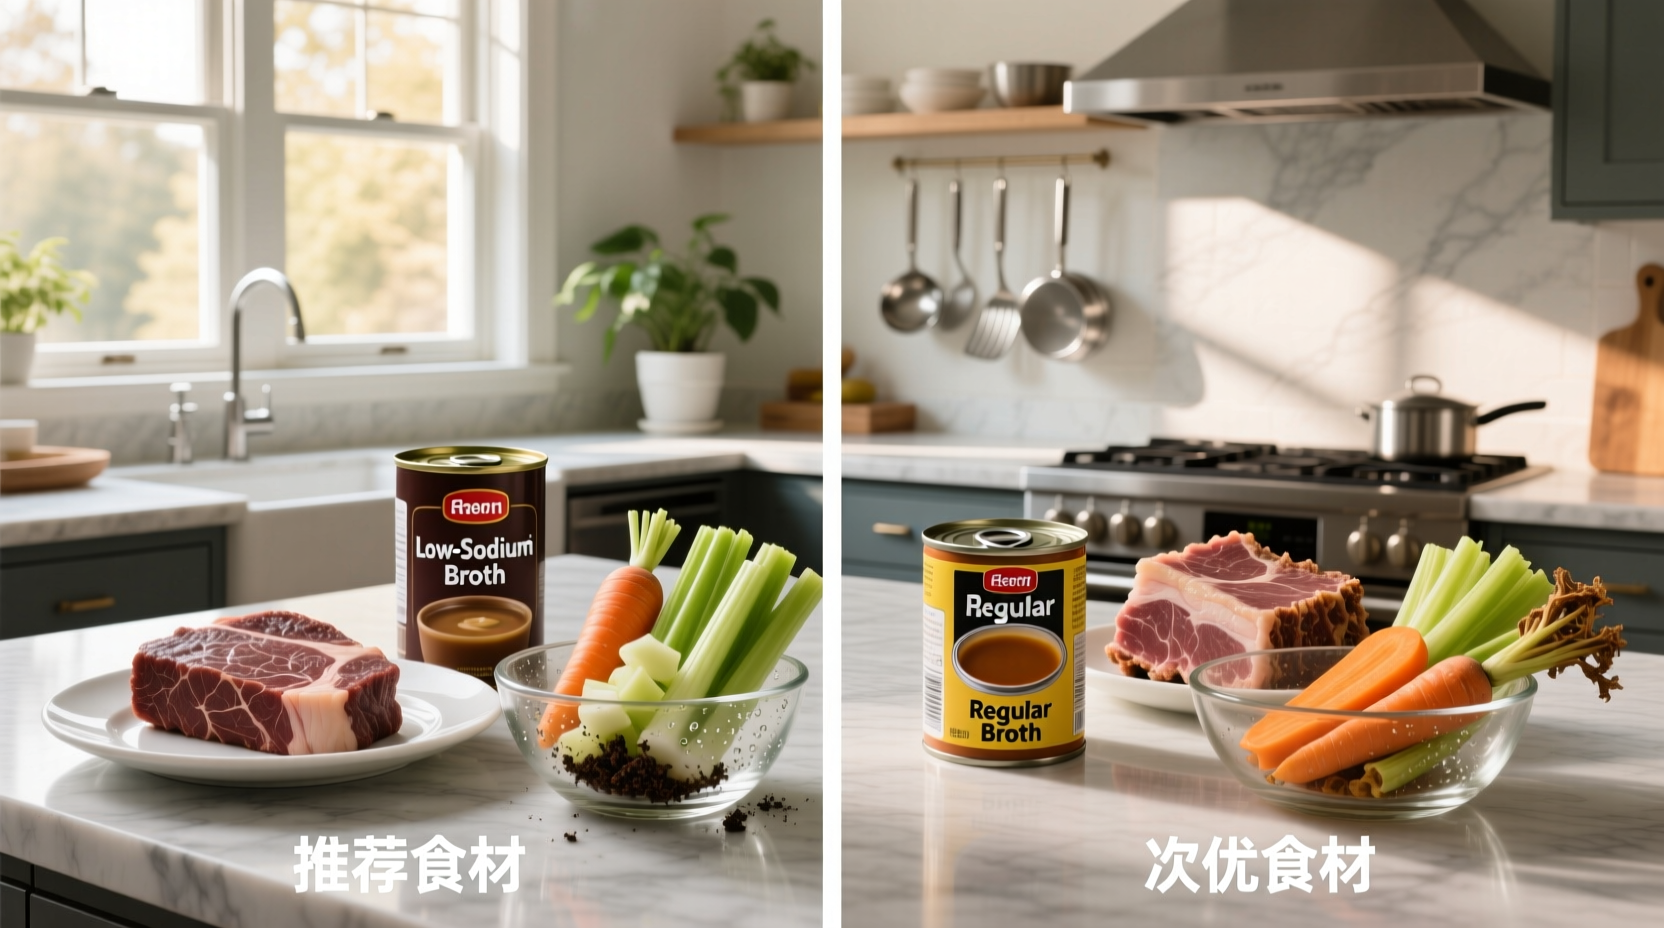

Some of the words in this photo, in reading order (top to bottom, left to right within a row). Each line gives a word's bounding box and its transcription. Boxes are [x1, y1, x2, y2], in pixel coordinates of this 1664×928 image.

[415, 534, 533, 560] Low-Sodium
[444, 562, 506, 586] Broth
[966, 593, 1056, 625] Regular
[969, 699, 1052, 726] Regular
[981, 722, 1042, 743] Broth
